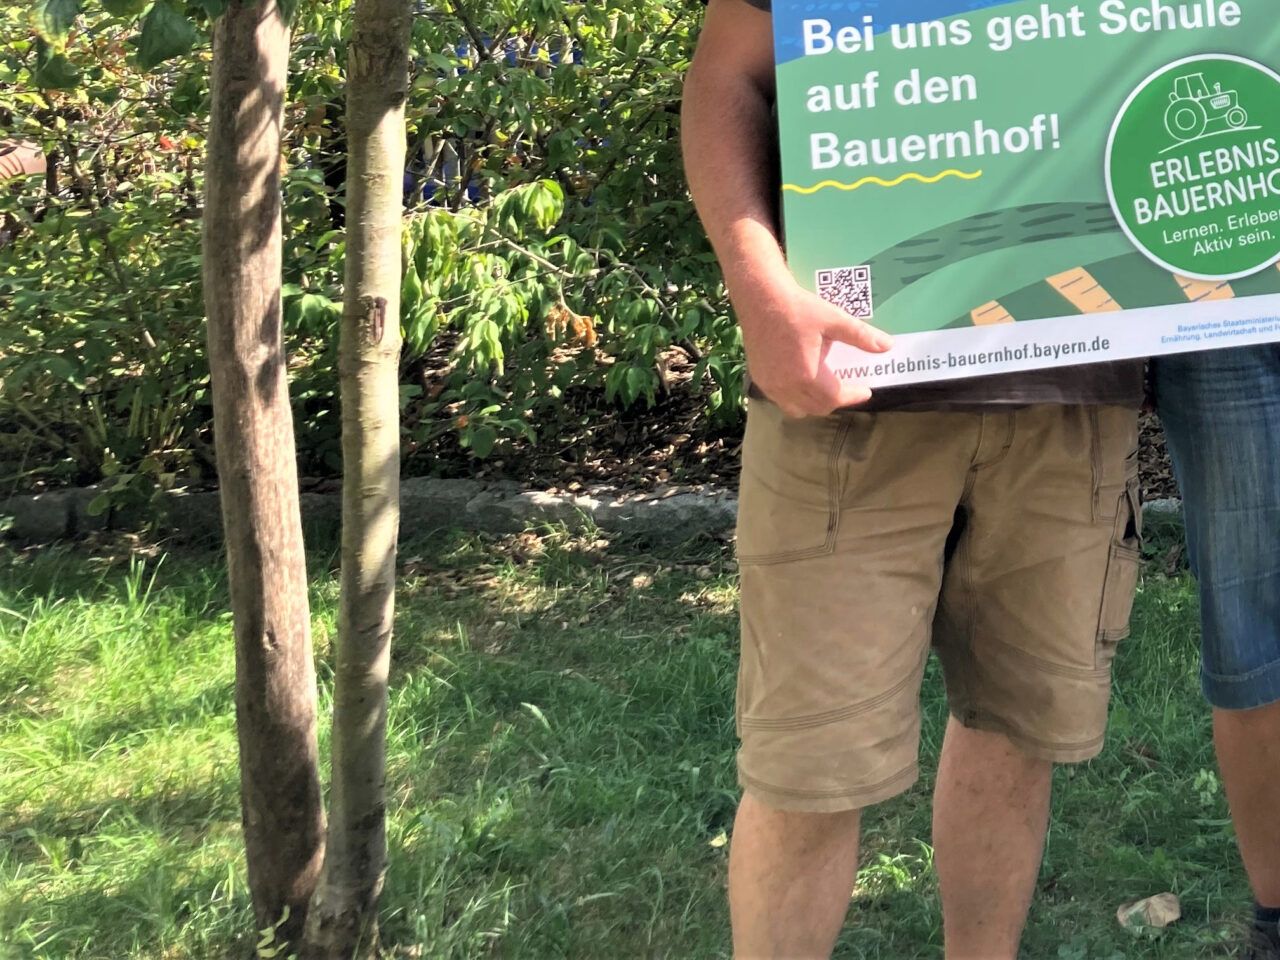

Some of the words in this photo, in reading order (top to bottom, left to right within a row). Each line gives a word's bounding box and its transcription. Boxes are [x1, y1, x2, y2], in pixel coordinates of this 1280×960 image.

[802, 16, 875, 56] Bei
[891, 17, 972, 52] uns
[987, 3, 1085, 52] geht
[806, 71, 879, 113] auf
[894, 69, 978, 106] den
[809, 113, 1062, 171] Bauernhof!
[1150, 138, 1280, 189] ERLEBNIS
[1162, 222, 1224, 245] Lernen.
[1193, 235, 1233, 257] Aktiv
[1238, 229, 1276, 247] sein.
[1177, 322, 1222, 332] Bayerisches
[1258, 324, 1273, 333] und
[833, 336, 1110, 380] ww.erlebnis-bauernhof.bayern.de
